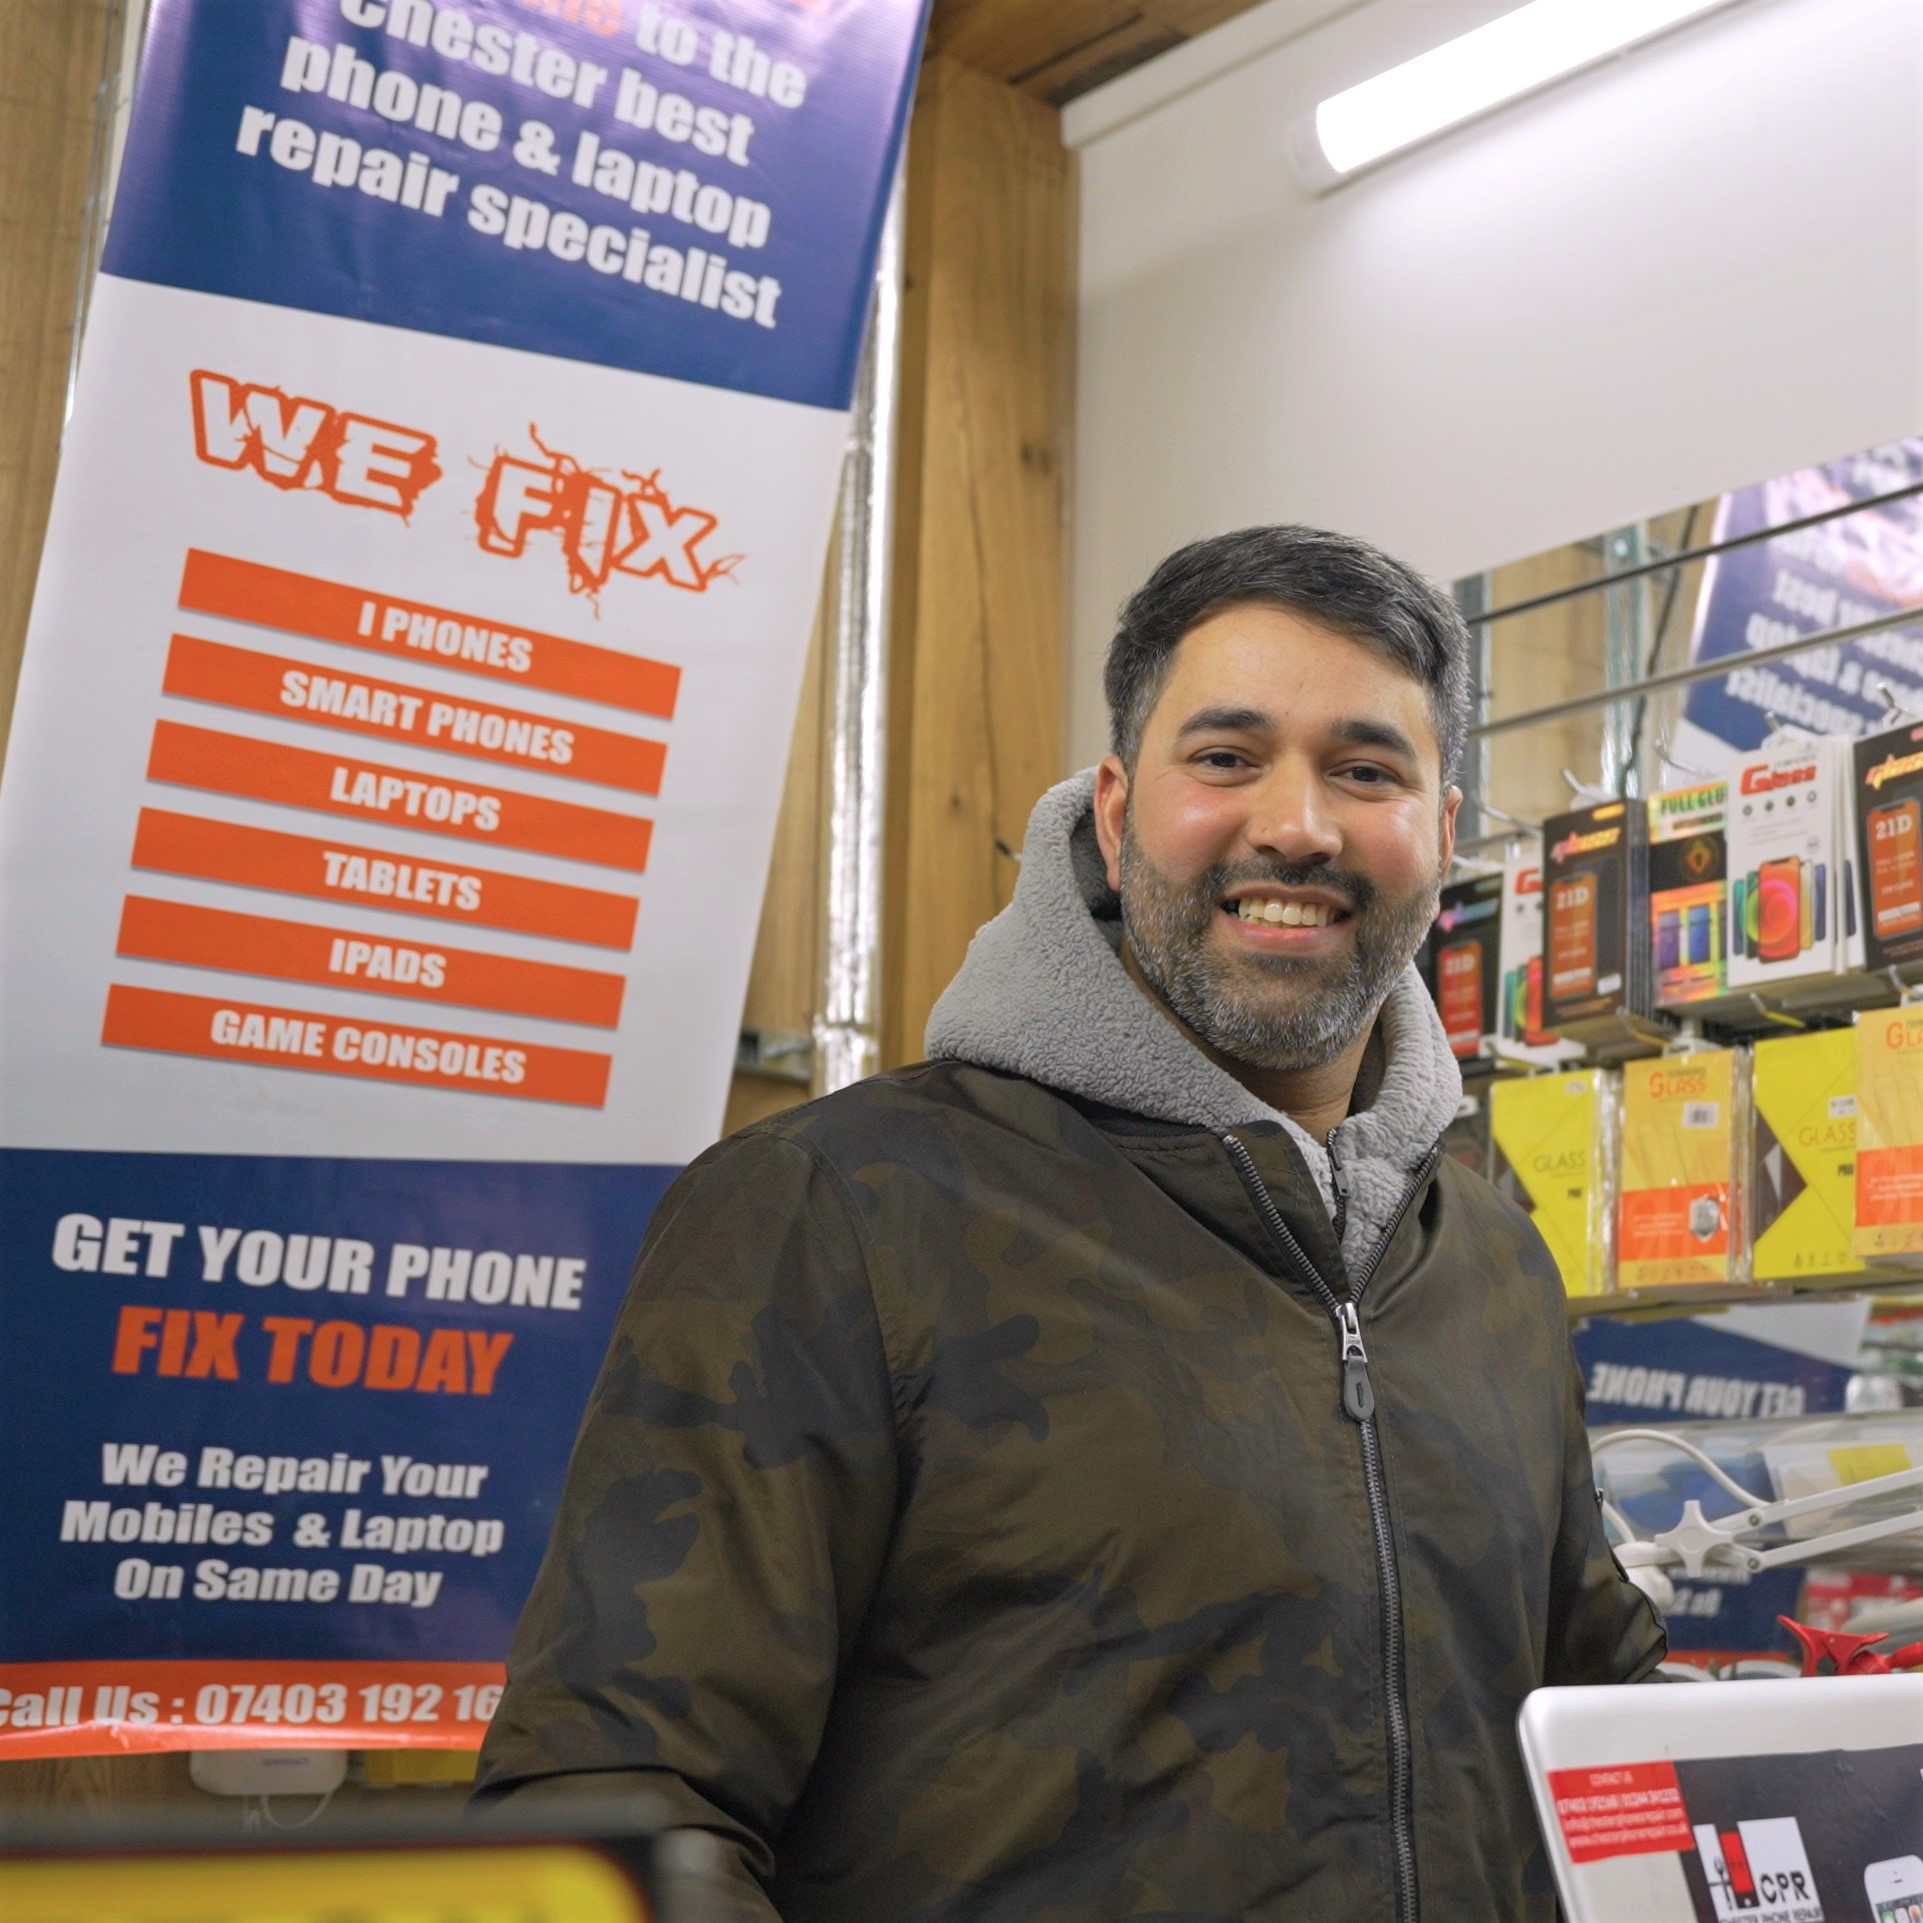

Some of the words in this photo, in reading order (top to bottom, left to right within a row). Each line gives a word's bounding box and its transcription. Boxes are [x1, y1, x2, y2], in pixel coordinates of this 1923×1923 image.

[635, 3, 699, 67] to
[708, 31, 808, 109] the
[281, 37, 504, 153] phone
[512, 119, 561, 176] &
[571, 130, 772, 249] laptop
[613, 67, 755, 167] best
[235, 104, 460, 218] repair
[467, 182, 782, 329] specialist
[190, 369, 443, 520] WE
[474, 438, 725, 602] FIX
[357, 601, 376, 636] I
[381, 606, 534, 674] PHONES
[279, 669, 424, 731] SMART
[426, 702, 576, 766] PHONES
[329, 766, 502, 832] LAPTOPS
[1875, 812, 1914, 841] 21D
[322, 851, 483, 911] TABLETS
[328, 938, 448, 989] IPADS
[210, 1008, 327, 1058] GAME
[332, 1025, 528, 1085] CONSOLES
[51, 1213, 186, 1278] GET
[198, 1225, 376, 1295] YOUR
[385, 1242, 587, 1311] PHONE
[111, 1305, 245, 1381] FIX
[262, 1316, 514, 1396] TODAY
[101, 1443, 188, 1488] We
[197, 1446, 372, 1495] Repair
[380, 1456, 489, 1500] Your
[59, 1499, 276, 1547] Mobiles
[292, 1512, 331, 1549] &
[339, 1508, 506, 1558] Laptop
[114, 1558, 186, 1601] On
[192, 1559, 341, 1603] Same
[347, 1563, 444, 1609] Day
[94, 1685, 161, 1726] Us
[195, 1683, 348, 1726] 07403
[362, 1683, 441, 1723] 192
[1760, 1870, 1811, 1904] CPR
